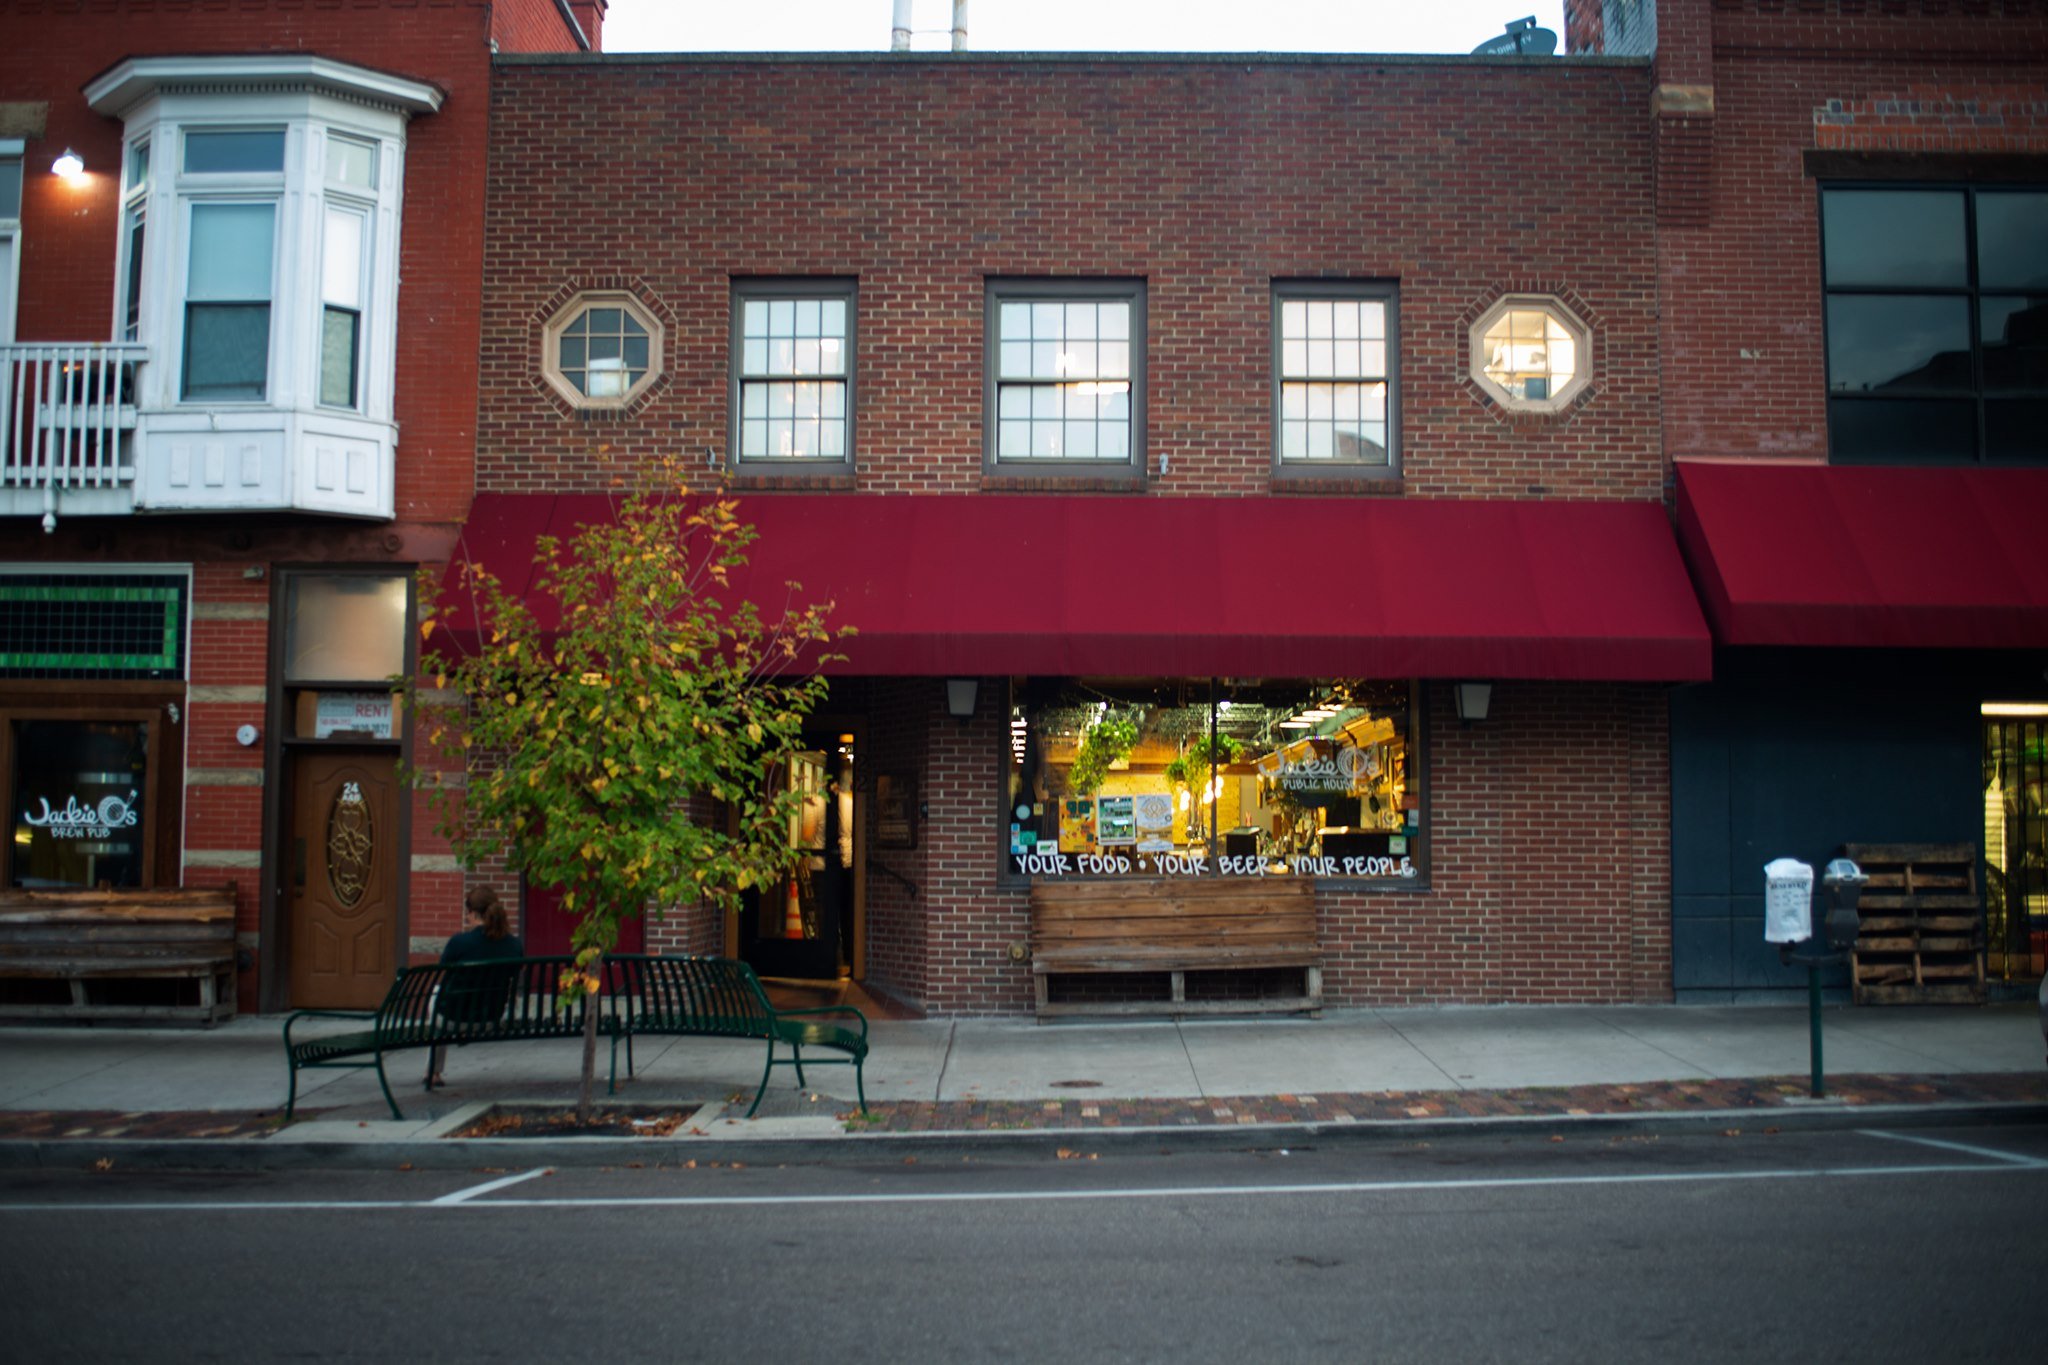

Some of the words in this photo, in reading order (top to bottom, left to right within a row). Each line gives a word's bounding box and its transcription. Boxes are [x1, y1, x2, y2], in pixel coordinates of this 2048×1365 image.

[355, 703, 389, 718] RENT
[1258, 746, 1339, 778] Jackie
[343, 782, 359, 793] 24
[1282, 779, 1321, 791] PUBLIC
[24, 795, 100, 827] Jackie
[51, 827, 83, 839] BREW
[86, 827, 111, 838] PUB
[1016, 854, 1072, 875] YOUR
[1077, 854, 1130, 874] FOOD
[1153, 854, 1210, 875] YOUR
[1219, 855, 1271, 876] BEER
[1290, 855, 1341, 876] YOUR
[1343, 856, 1412, 877] PEOPLE
